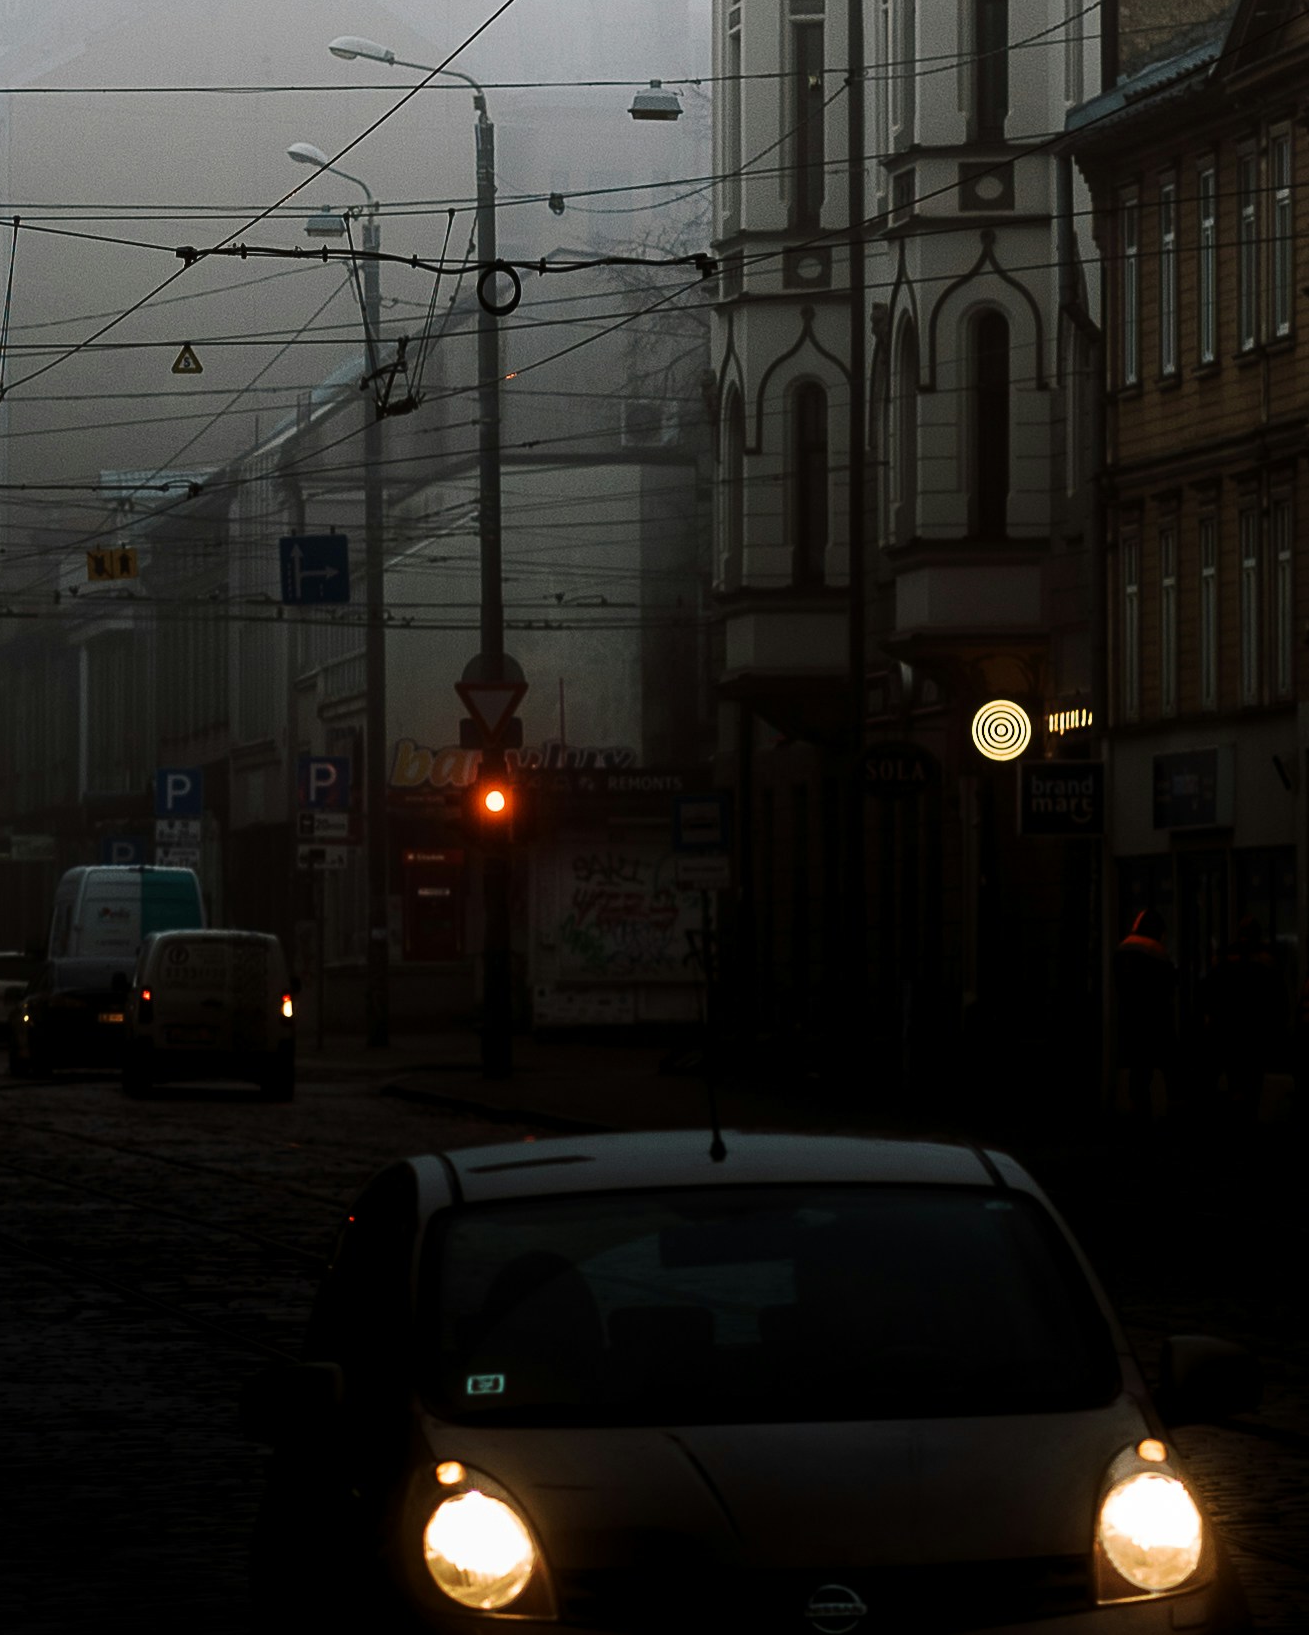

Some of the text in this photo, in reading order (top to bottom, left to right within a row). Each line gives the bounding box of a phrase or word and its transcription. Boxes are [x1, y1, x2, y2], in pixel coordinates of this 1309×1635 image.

[309, 762, 337, 802] P
[865, 758, 927, 782] SOLA
[166, 773, 192, 810] P
[607, 775, 684, 791] REMONTS
[1031, 773, 1093, 796] brand
